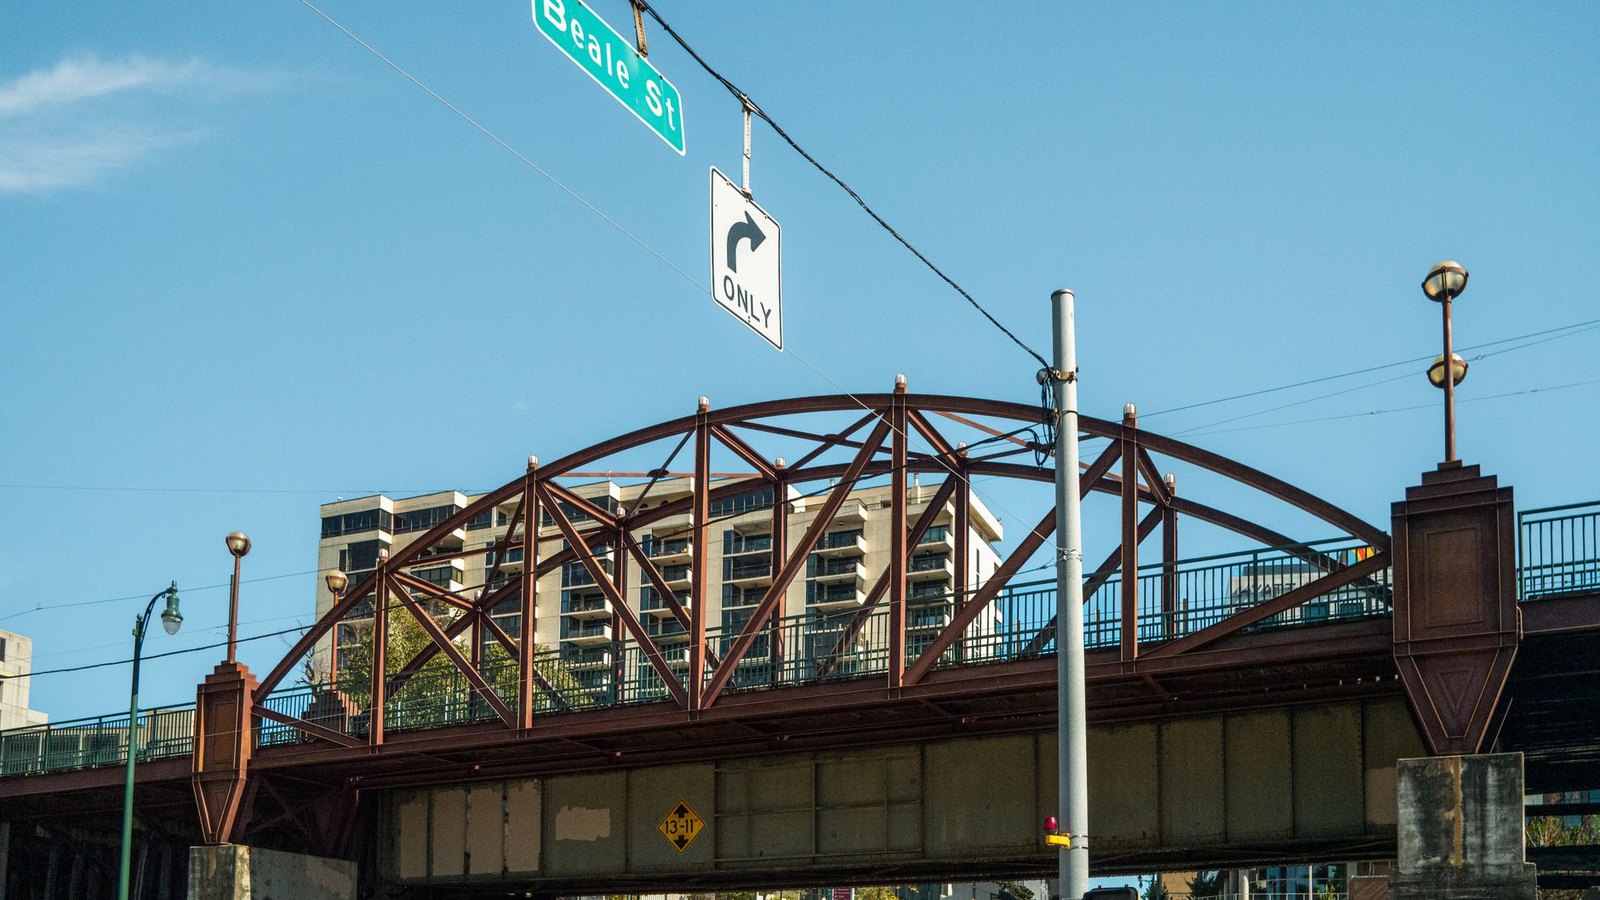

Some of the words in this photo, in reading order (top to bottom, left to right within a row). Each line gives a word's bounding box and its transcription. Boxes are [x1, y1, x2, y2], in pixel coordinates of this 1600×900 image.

[543, 0, 629, 89] Beale
[645, 79, 676, 131] St
[724, 275, 772, 328] ONLY
